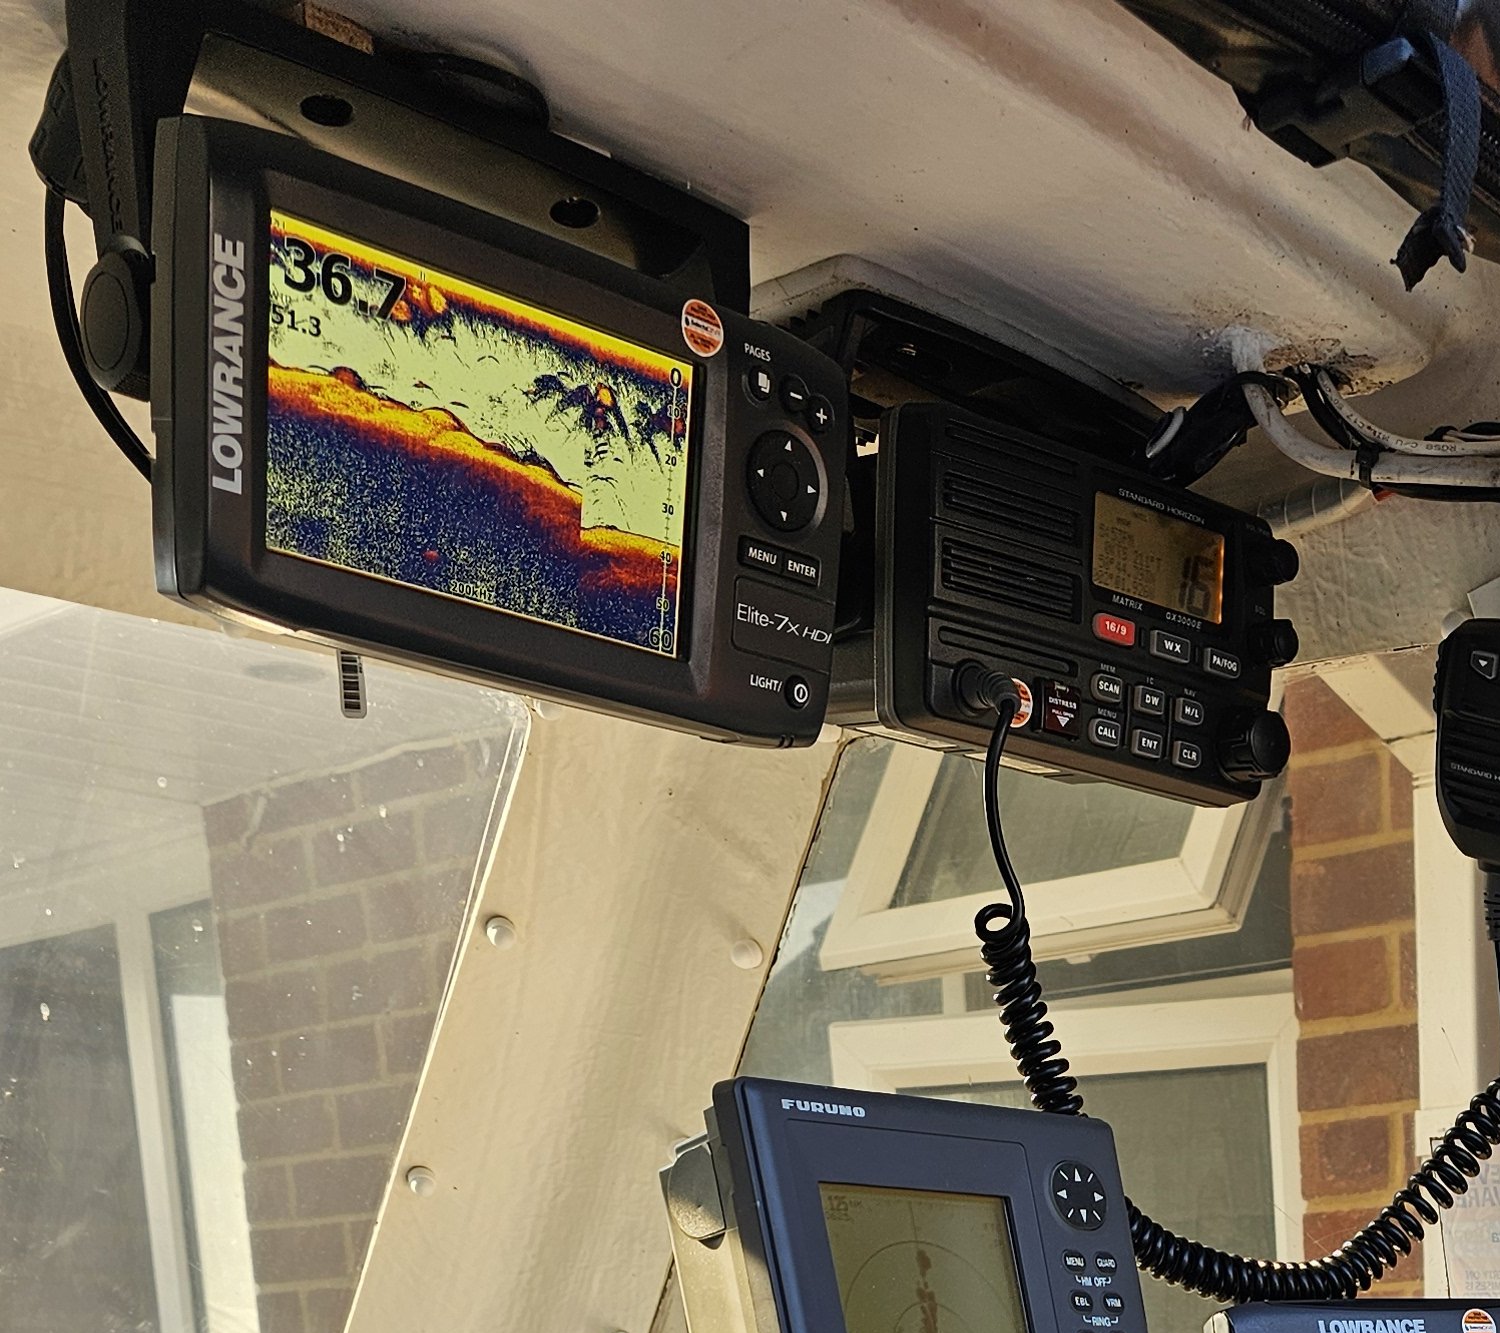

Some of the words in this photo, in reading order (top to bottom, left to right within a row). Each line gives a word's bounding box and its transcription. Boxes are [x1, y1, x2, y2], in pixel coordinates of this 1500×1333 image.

[284, 235, 407, 321] 36.7
[271, 304, 321, 338] 51.3
[744, 342, 772, 363] PAGES
[212, 232, 245, 495] LOWRANCE
[665, 454, 677, 467] 20
[662, 502, 674, 516] 30
[1118, 488, 1165, 511] STANDARD
[1166, 505, 1206, 526] HORIZON
[660, 550, 671, 564] 40
[748, 547, 778, 565] MENU
[787, 560, 816, 579] ENTER
[450, 580, 496, 602] 200kHz
[657, 598, 669, 611] 50
[1112, 594, 1143, 611] MATRIX
[1105, 620, 1127, 636] 16/9
[649, 628, 672, 649] 60
[802, 626, 833, 645] HDI
[1164, 639, 1182, 653] WX
[1212, 655, 1237, 672] PA/FOG
[1098, 680, 1120, 695] SCAN
[1048, 696, 1077, 710] DISTRESS
[1145, 694, 1160, 706] DW
[1184, 704, 1200, 718] H/L
[1097, 726, 1117, 740] CALL
[1141, 738, 1158, 750] ENT
[1182, 749, 1197, 762] CLR
[1450, 762, 1492, 780] STANDARD
[780, 1098, 866, 1118] FURUNO
[1066, 1256, 1085, 1267] MENU
[1096, 1258, 1116, 1268] GUARD
[1093, 1277, 1107, 1287] OFF
[1075, 1296, 1091, 1306] EBL
[1106, 1298, 1122, 1308] VRM
[1091, 1316, 1112, 1327] RING
